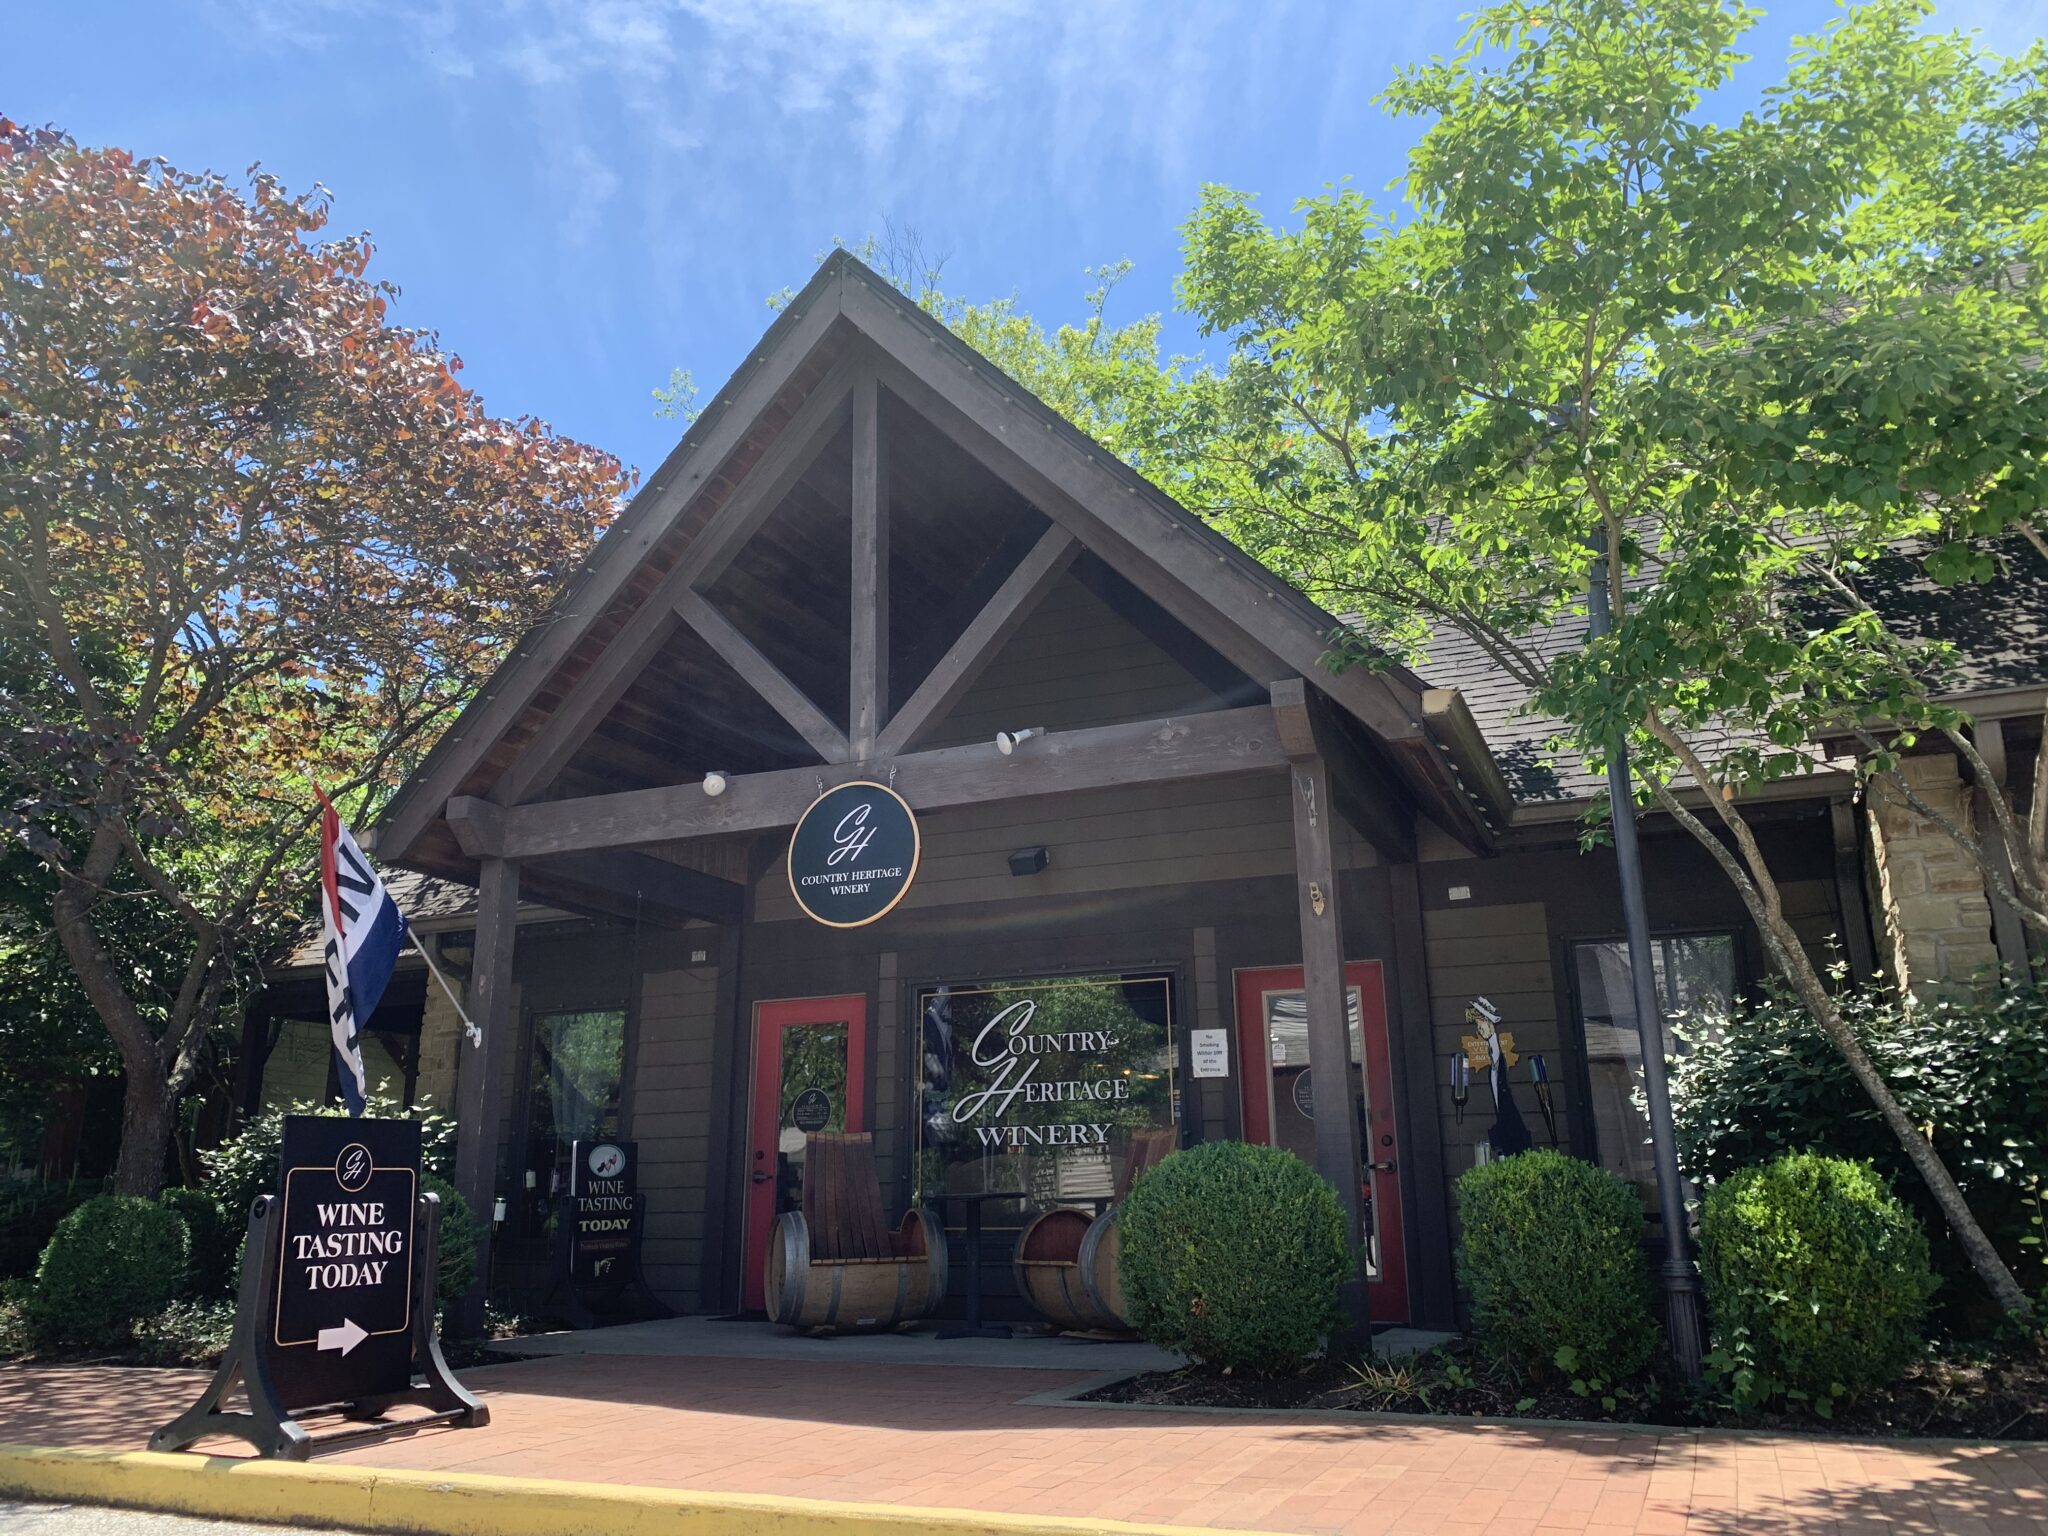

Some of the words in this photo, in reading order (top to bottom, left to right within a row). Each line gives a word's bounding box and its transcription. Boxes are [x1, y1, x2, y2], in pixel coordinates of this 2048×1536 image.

[801, 872, 849, 885] COUNTRY
[851, 867, 902, 880] HERITAGE
[830, 883, 870, 895] WINERY
[971, 999, 1112, 1067] COUNTRY
[952, 1057, 1129, 1123] HERITAGE
[974, 1123, 1113, 1147] WINERY
[588, 1180, 625, 1195] WINE
[316, 1203, 385, 1227] WINE
[578, 1196, 633, 1212] TASTING
[578, 1218, 631, 1232] TODAY
[292, 1230, 403, 1260] TASTING
[304, 1261, 389, 1290] TODAY
